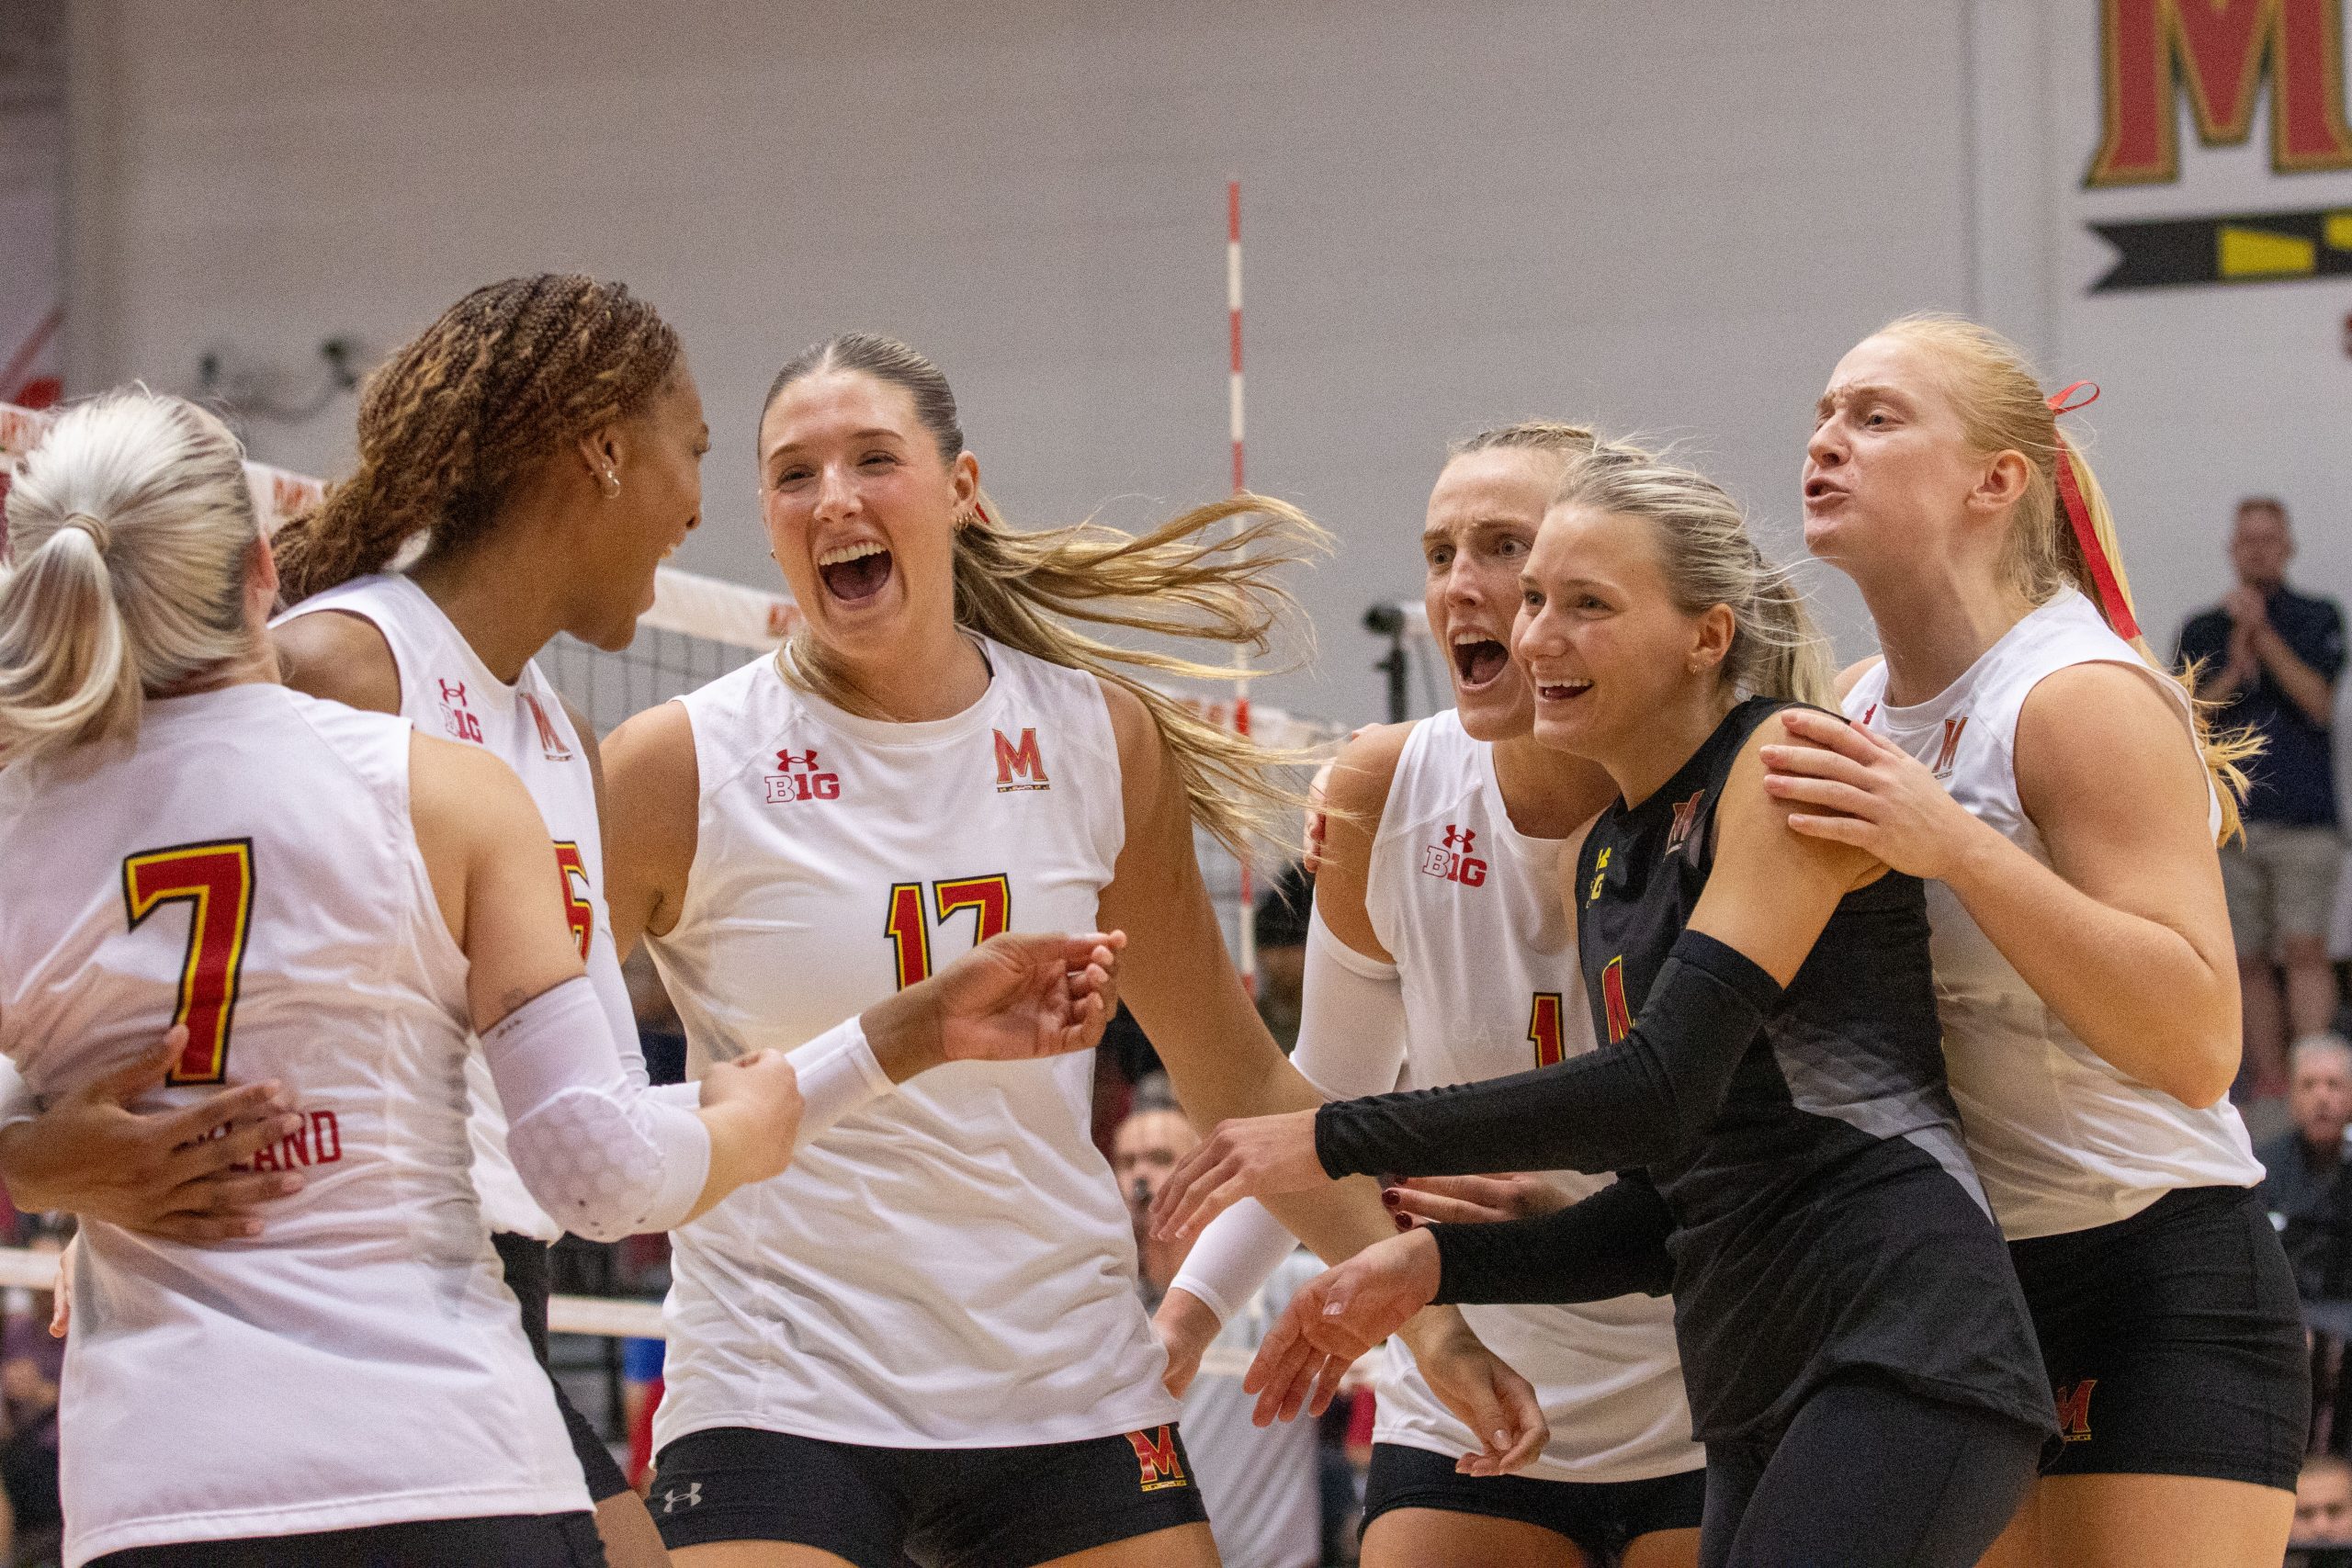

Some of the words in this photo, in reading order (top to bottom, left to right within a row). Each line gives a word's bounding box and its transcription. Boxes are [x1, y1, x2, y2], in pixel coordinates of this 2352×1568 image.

[2080, 0, 2352, 189] M
[992, 728, 1049, 784] M
[1931, 716, 1969, 773] M
[122, 837, 256, 1087] 7
[883, 873, 1012, 993] 17
[1124, 1425, 1185, 1483] M
